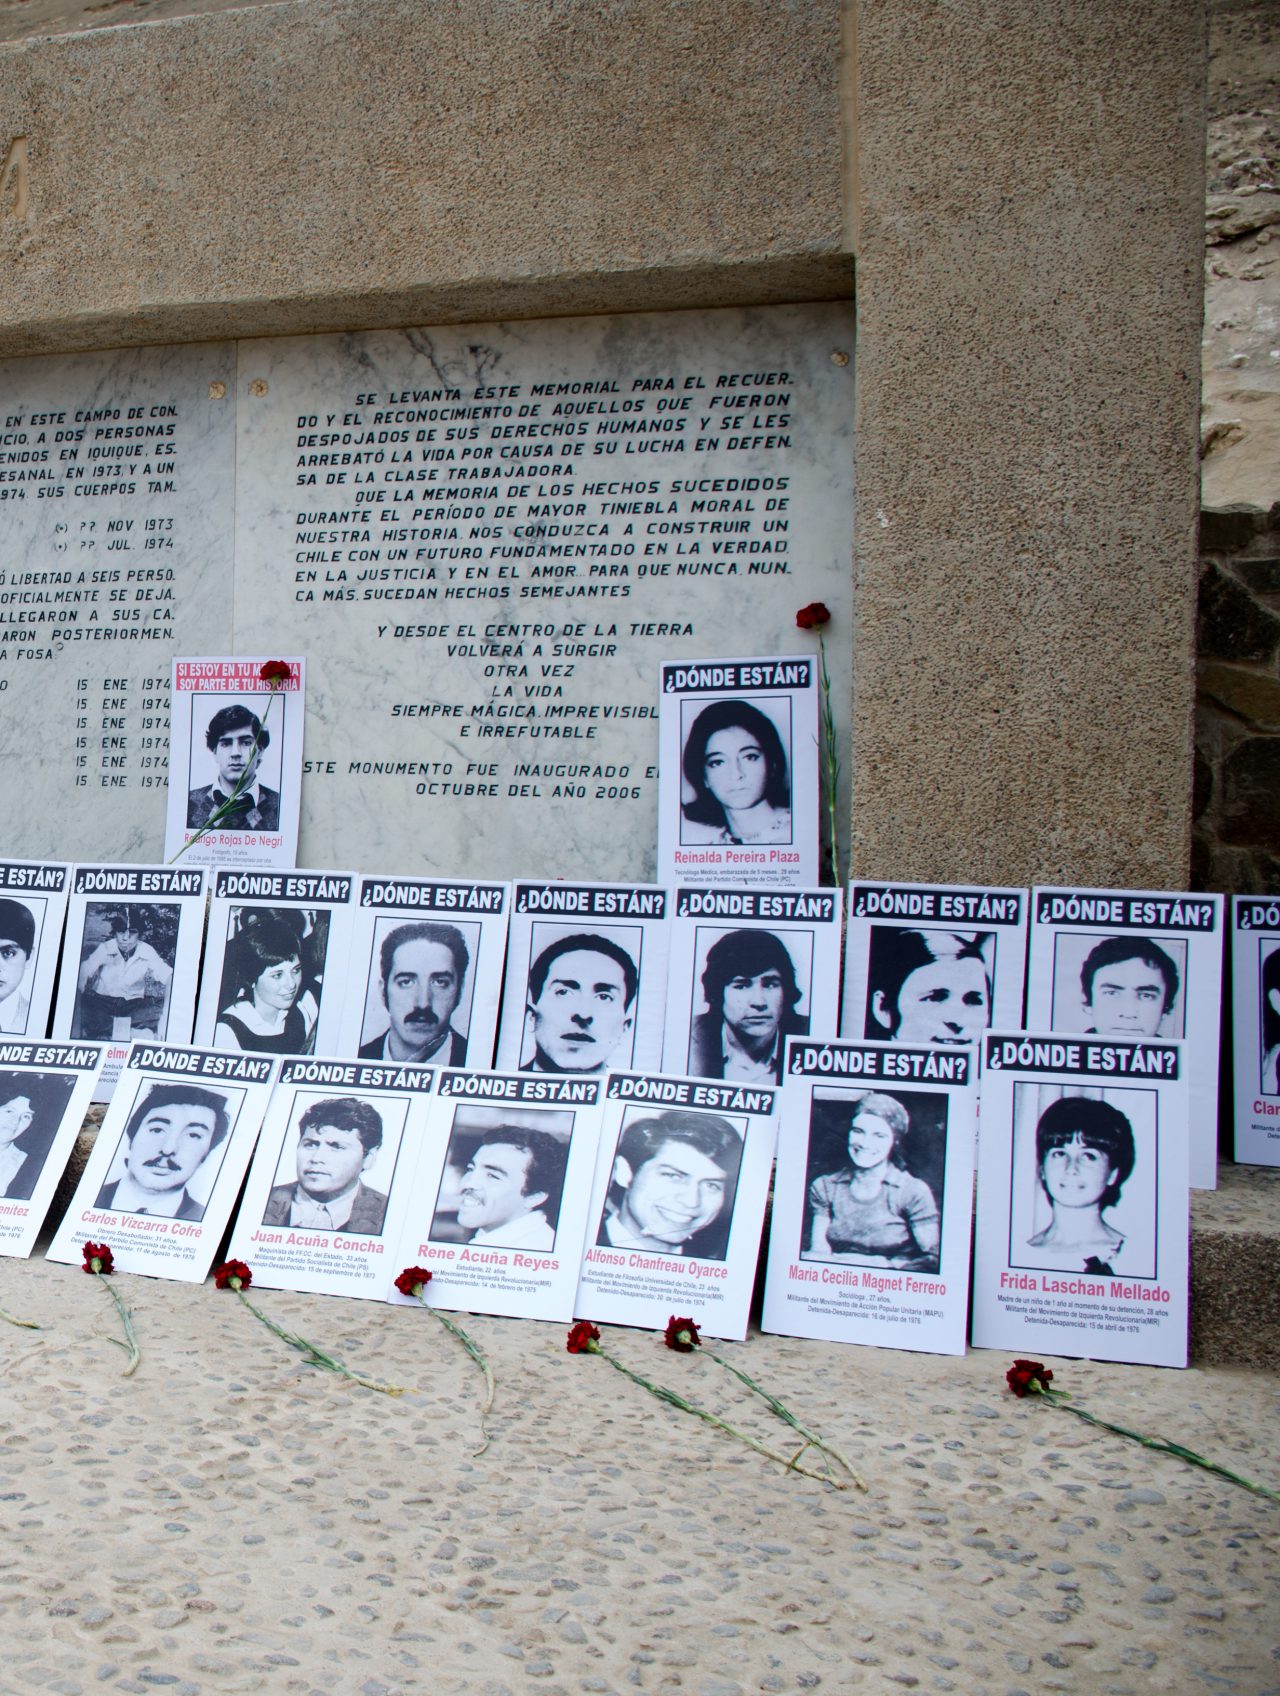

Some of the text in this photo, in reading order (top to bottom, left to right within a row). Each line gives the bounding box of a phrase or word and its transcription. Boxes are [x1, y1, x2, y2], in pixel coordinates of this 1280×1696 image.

[297, 393, 791, 429] DO Y EL RECONOCIMIENTO DE AQUELLOS QUE FUERON
[296, 473, 317, 486] SA
[326, 472, 347, 485] DE
[354, 471, 375, 483] LA
[384, 469, 439, 482] CLASE
[377, 623, 694, 638] Y DESDE EL CENTRO DE LA TIERRA
[532, 644, 542, 657] A
[552, 644, 617, 657] SURGIR
[178, 664, 187, 677] SI
[189, 664, 220, 677] ESTOY
[222, 664, 235, 677] EN
[238, 664, 252, 677] TU
[484, 664, 575, 677] OTRA VEZ
[666, 662, 807, 692] ¿DÓNDE ESTÁN?
[179, 678, 197, 691] SOY
[198, 678, 227, 691] PARTE
[228, 678, 241, 691] DE
[241, 678, 254, 691] TU
[492, 685, 562, 698] LA VIDA
[460, 725, 597, 739] E IRREFUTABLE
[75, 775, 88, 786] 15
[101, 775, 128, 787] ENE
[416, 782, 641, 799] OCTUBRE DEL AÑO 2006
[219, 834, 242, 848] Rojas
[244, 835, 257, 846] De
[259, 835, 283, 849] Negri
[674, 850, 800, 864] Reinalda Pereira Plaza
[363, 881, 502, 909] ¿DÓNDE ESTÁN?
[519, 889, 663, 914] ¿DÓNDE ESTÁN?
[857, 888, 1017, 920] ¿DÓNDE ESTÁN?
[1042, 891, 1213, 927] ¿DÓNDE ESTÁN?
[130, 1047, 270, 1079] ¿DÓNDE ESTÁN?
[792, 1044, 966, 1079] ¿DÓNDE ESTÁN?
[991, 1042, 1175, 1074] ¿DÓNDE ESTÁN?
[283, 1061, 431, 1088] ¿DÓNDE ESTÁN?
[441, 1074, 596, 1100] ¿DÓNDE ESTÁN?
[609, 1079, 772, 1111] ¿DÓNDE ESTÁN?
[82, 1211, 202, 1237] Carlos Vizcarra Cofré
[251, 1230, 384, 1253] Juan Acuña Concha
[419, 1245, 557, 1270] Rene Acuña Reyes
[585, 1249, 727, 1279] Alfonso Chanfreau Oyarce
[822, 1268, 858, 1286] Cecilia
[862, 1273, 902, 1293] Magnet
[906, 1277, 946, 1295] Ferrero
[1000, 1272, 1170, 1303] Frida Laschan Mellado
